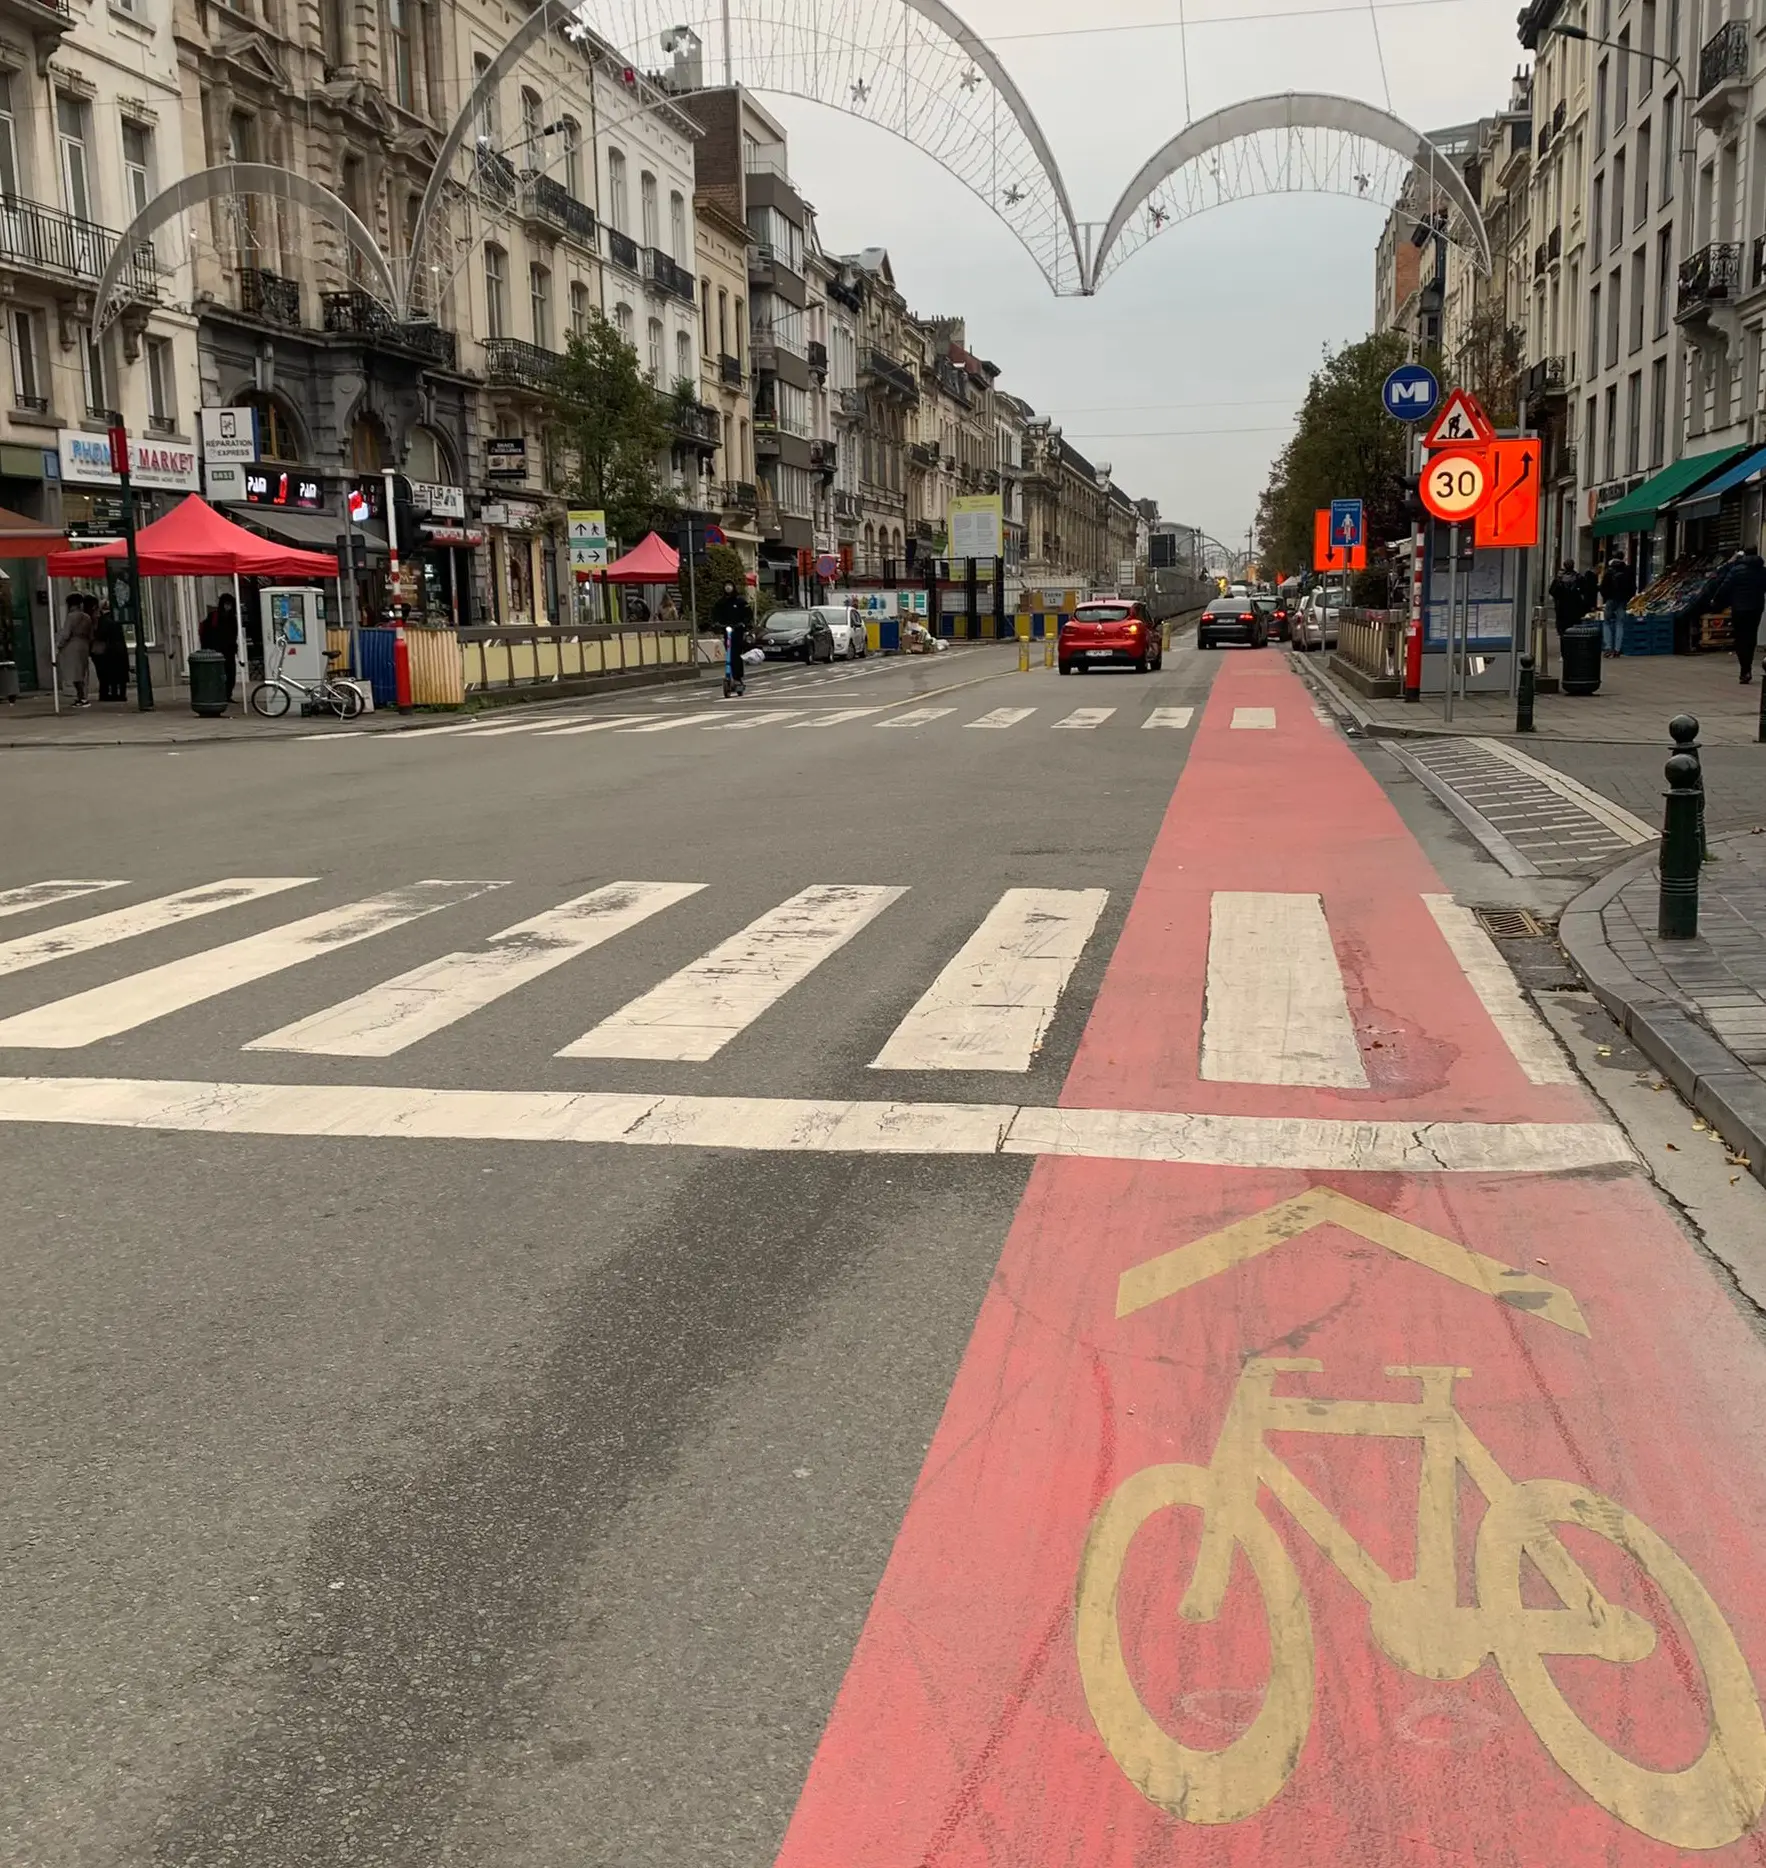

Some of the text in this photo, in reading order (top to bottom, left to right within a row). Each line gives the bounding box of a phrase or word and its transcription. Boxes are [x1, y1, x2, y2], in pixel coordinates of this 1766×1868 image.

[1391, 380, 1430, 404] M
[138, 447, 195, 473] MARKET
[1436, 470, 1476, 498] 30
